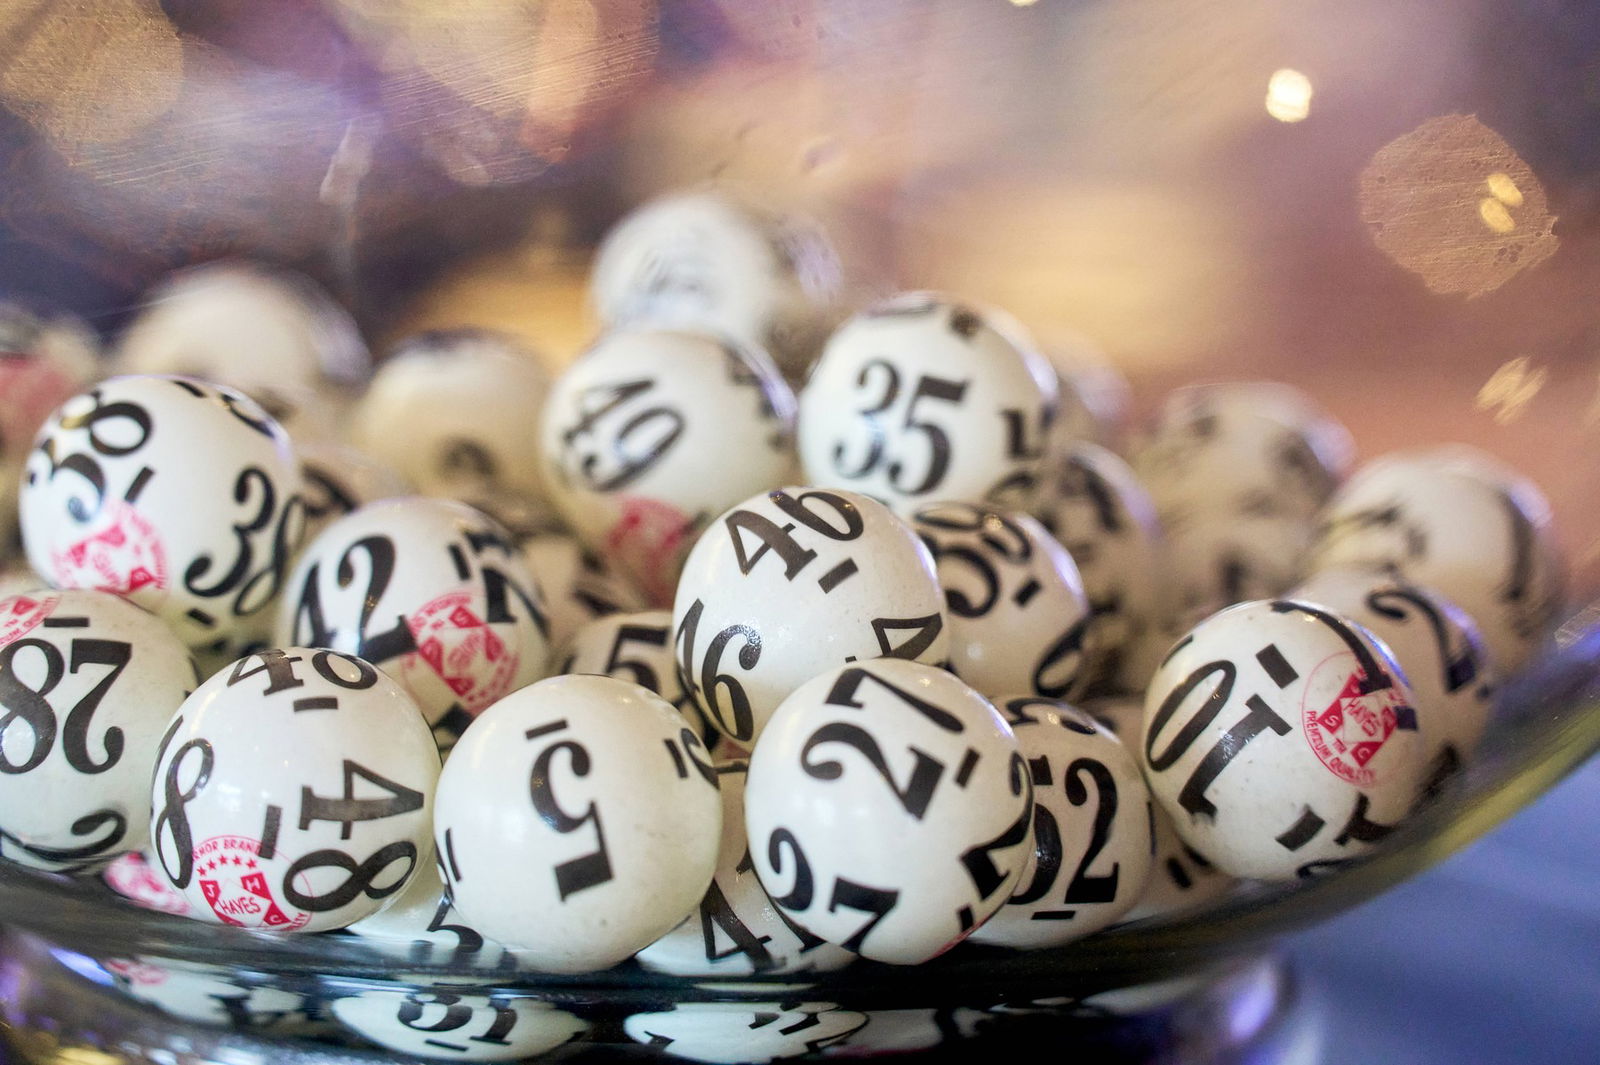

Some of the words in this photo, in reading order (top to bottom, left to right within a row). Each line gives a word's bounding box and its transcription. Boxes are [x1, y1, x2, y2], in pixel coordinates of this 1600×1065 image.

[830, 360, 970, 497] 35
[184, 465, 300, 617] 38
[288, 532, 420, 670] 12
[725, 488, 864, 582] 46
[0, 637, 132, 774] 28
[800, 667, 966, 821] 27
[1144, 659, 1293, 824] 10
[151, 715, 214, 890] 8
[283, 758, 425, 913] 48
[530, 739, 615, 904] 5
[219, 896, 262, 916] HAYES
